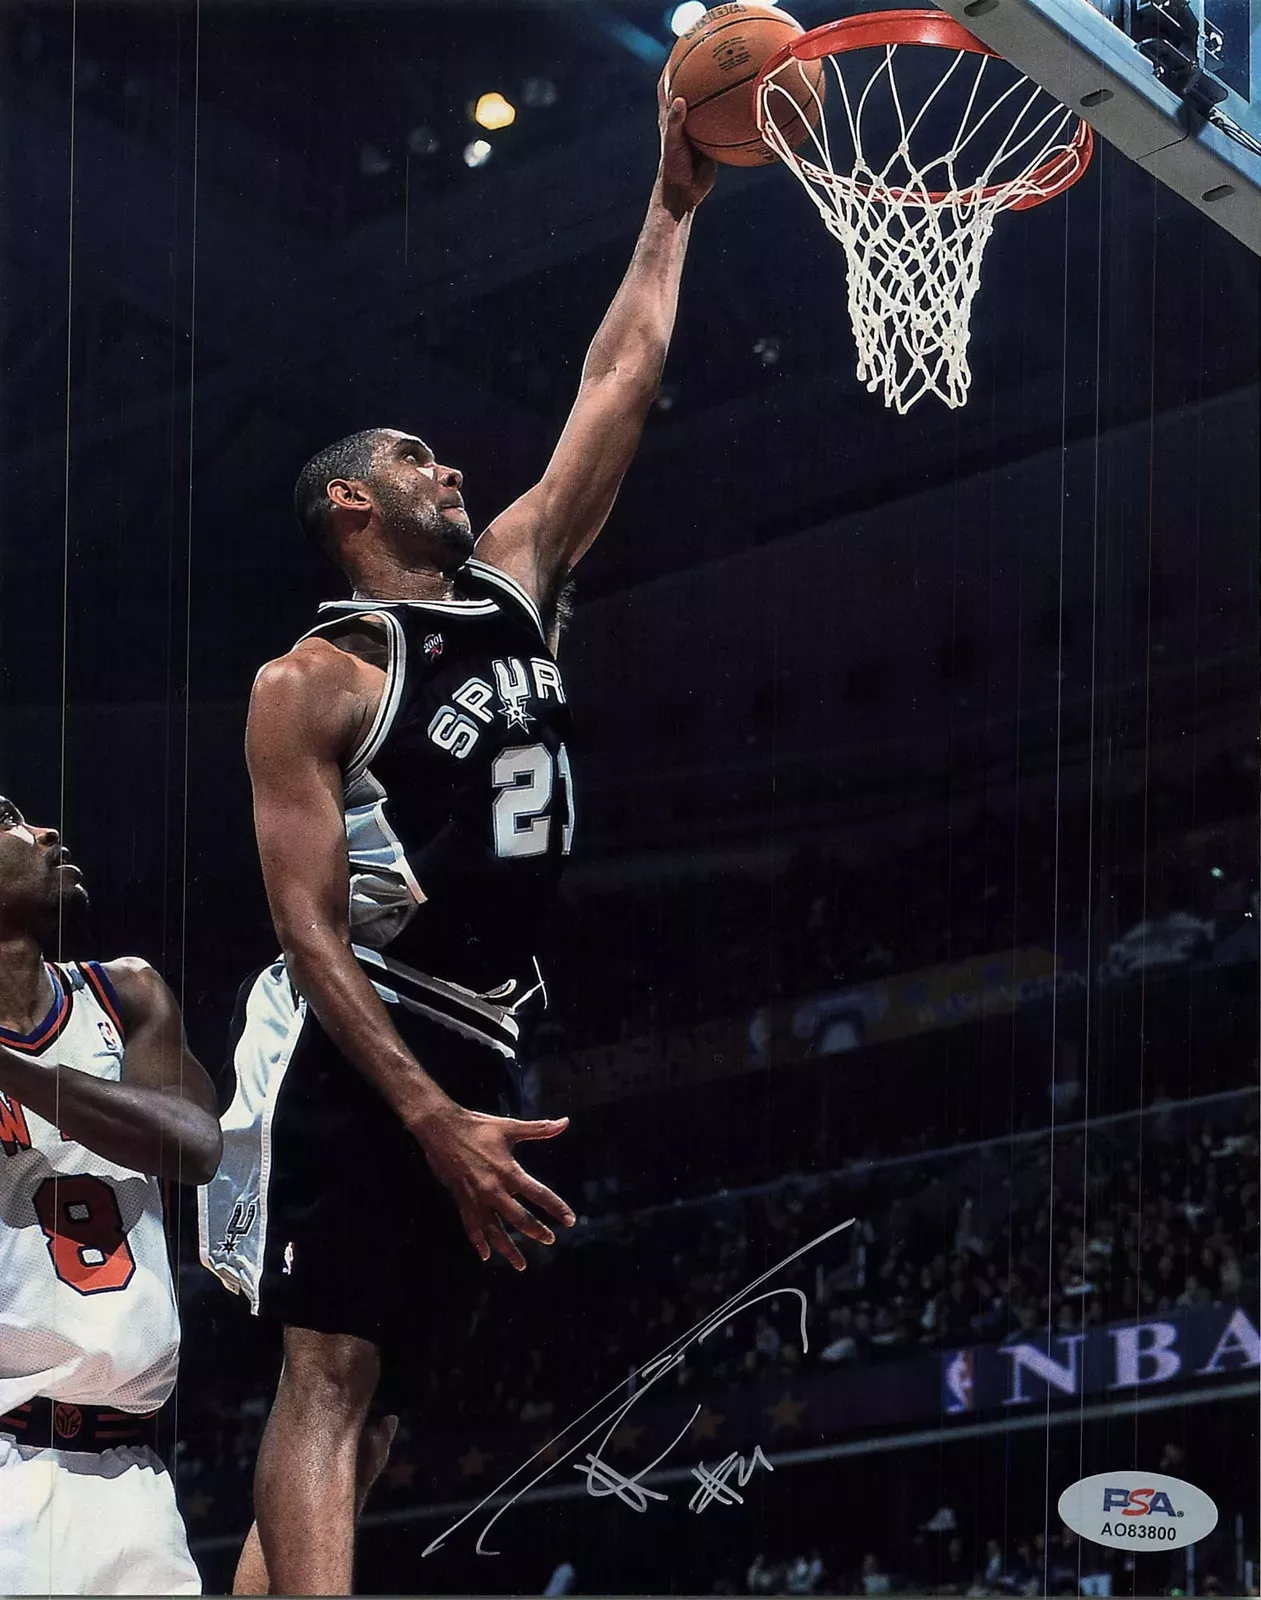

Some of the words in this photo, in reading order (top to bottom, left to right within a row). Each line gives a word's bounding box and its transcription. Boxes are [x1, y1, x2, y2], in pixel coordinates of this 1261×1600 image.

[423, 633, 443, 654] 2001
[428, 656, 567, 760] SPUR
[491, 742, 575, 858] 21
[32, 1173, 137, 1296] 8
[998, 1306, 1261, 1406] NBA
[1102, 1487, 1177, 1518] PSA
